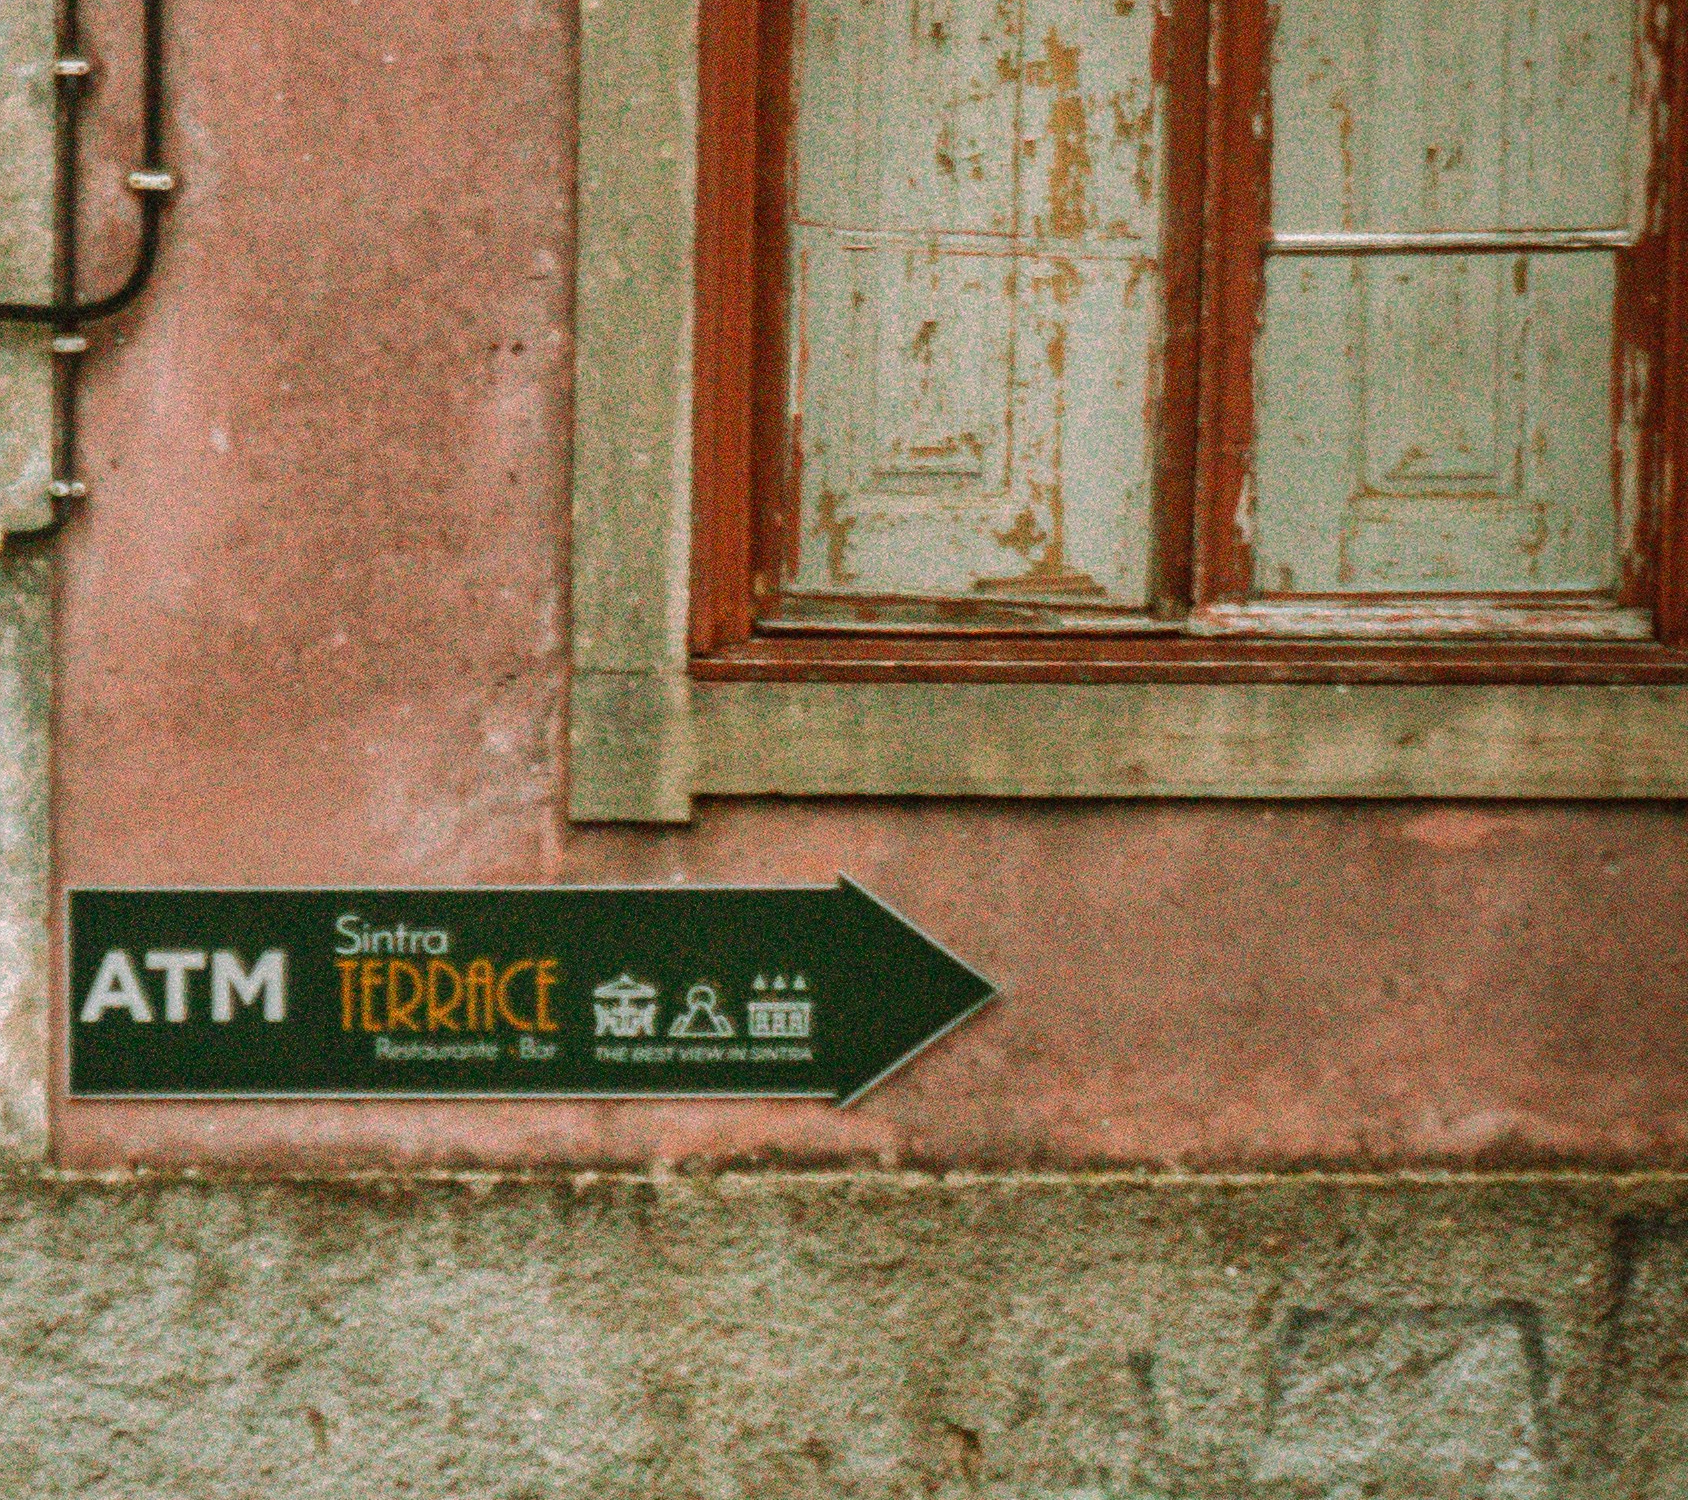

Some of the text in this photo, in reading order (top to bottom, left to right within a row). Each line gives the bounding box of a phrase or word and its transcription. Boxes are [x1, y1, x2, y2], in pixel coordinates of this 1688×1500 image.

[335, 914, 449, 955] Sintra
[79, 949, 288, 1024] ATM
[335, 958, 559, 1032] TERRACE
[374, 1036, 557, 1060] Restaurante Bar
[595, 1046, 629, 1062] THE
[631, 1046, 673, 1062] BEST
[749, 1046, 812, 1062] SINTRA
